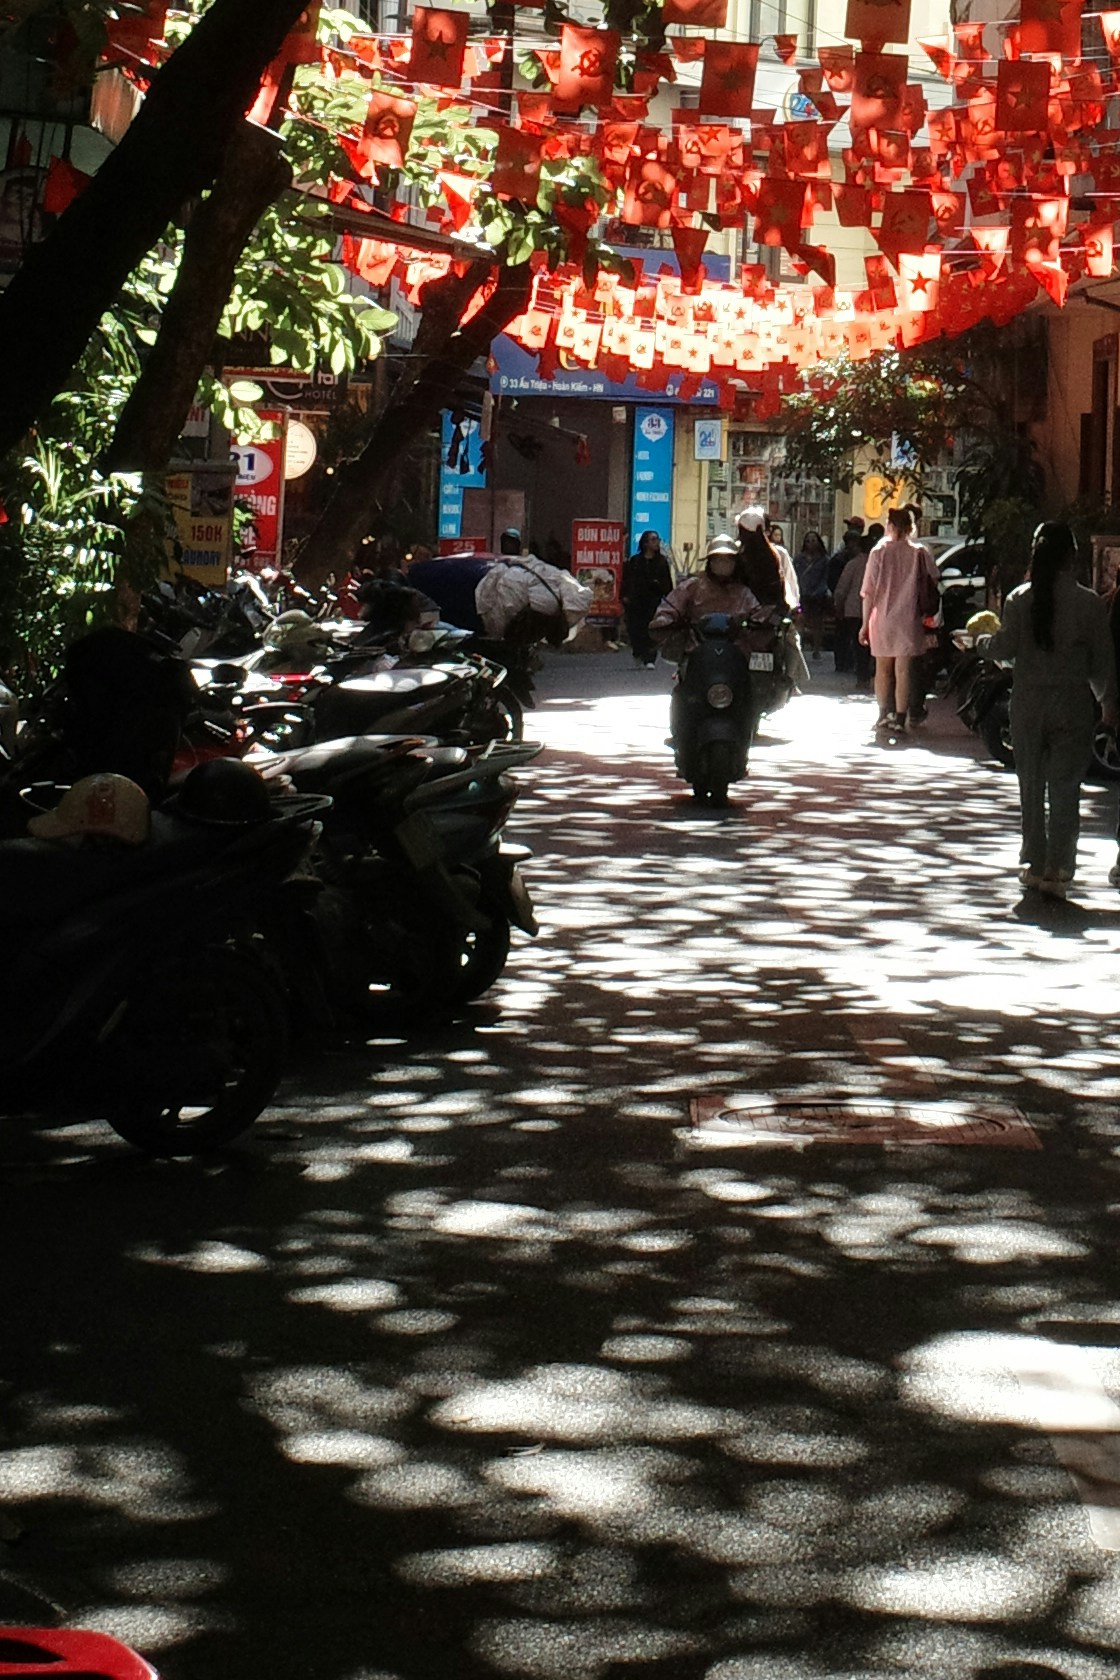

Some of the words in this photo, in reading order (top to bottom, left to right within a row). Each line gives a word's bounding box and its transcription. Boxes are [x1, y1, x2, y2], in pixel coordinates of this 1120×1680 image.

[303, 390, 337, 400] HOTEL
[191, 525, 223, 542] 150K
[452, 540, 476, 552] 25
